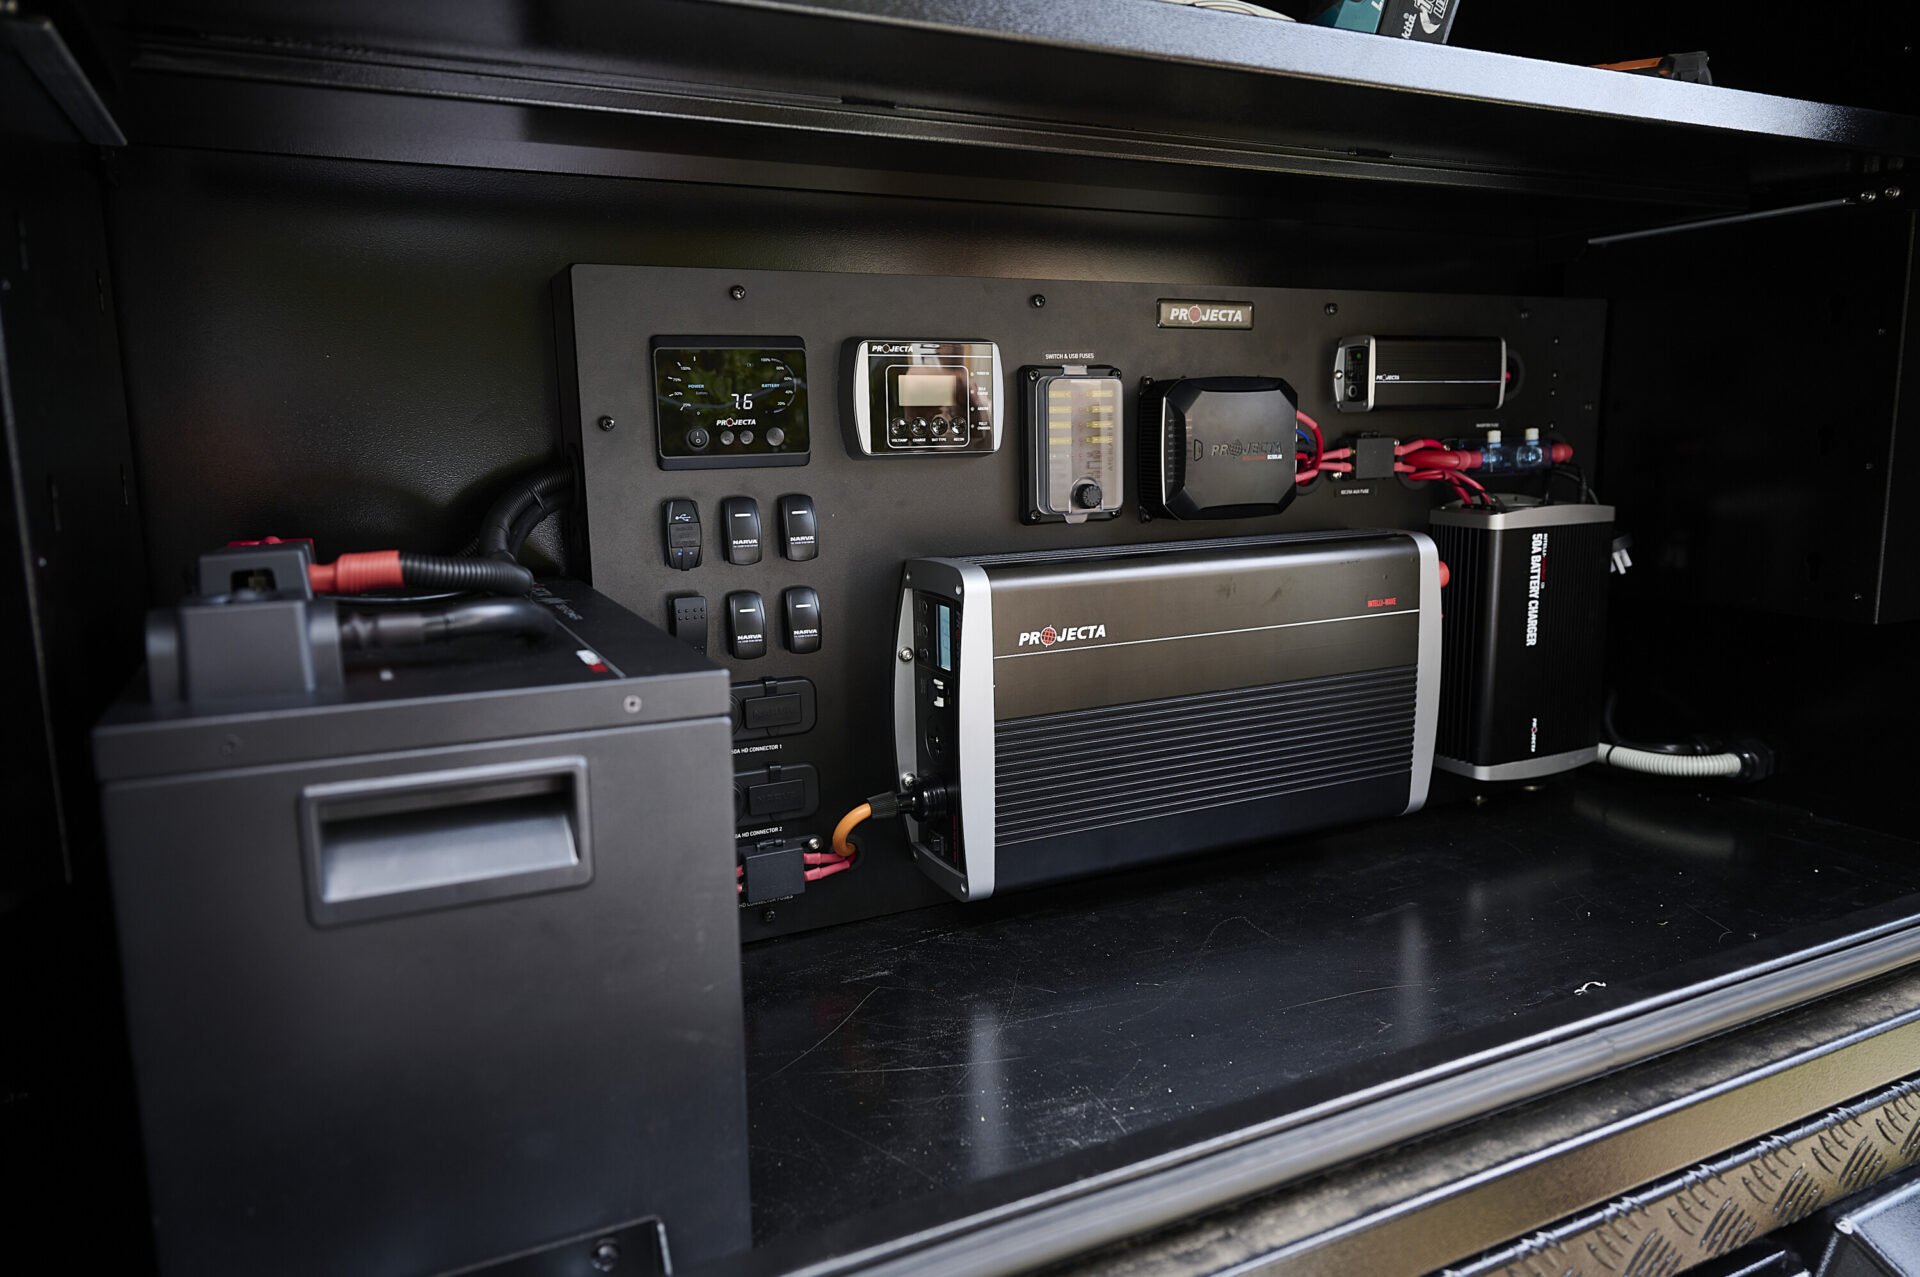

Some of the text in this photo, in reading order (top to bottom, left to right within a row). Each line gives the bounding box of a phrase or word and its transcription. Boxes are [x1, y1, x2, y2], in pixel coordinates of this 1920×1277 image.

[1401, 12, 1417, 39] kita
[1170, 304, 1243, 324] PROJECTA
[872, 344, 913, 353] PROJECTA
[716, 417, 757, 427] PROJECTA
[1526, 533, 1543, 647] 50A BATTERY CHARGER
[793, 628, 818, 636] NARVA
[1018, 624, 1107, 648] PROJECTA
[738, 633, 763, 641] NARVA
[749, 744, 778, 753] CONNECTOR
[749, 827, 779, 836] CONNECTOR
